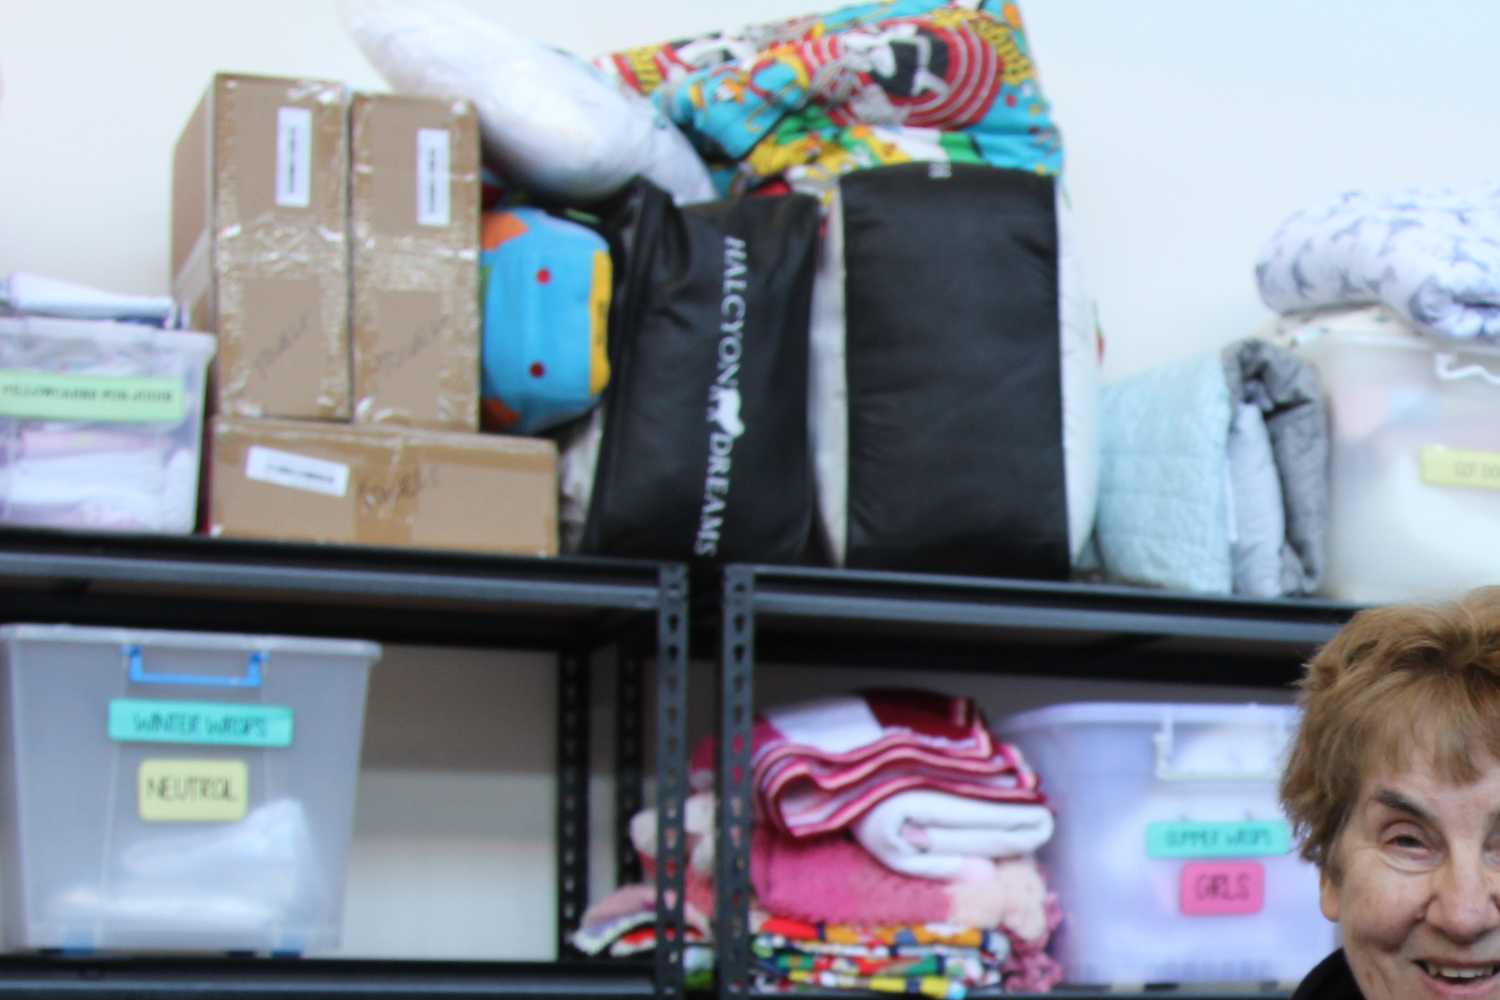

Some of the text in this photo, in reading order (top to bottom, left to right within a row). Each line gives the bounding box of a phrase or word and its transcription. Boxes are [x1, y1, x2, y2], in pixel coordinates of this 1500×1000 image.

[694, 235, 748, 557] HALCYON DREAMS
[133, 713, 199, 733] WINTER
[1194, 872, 1252, 901] GIRLS
